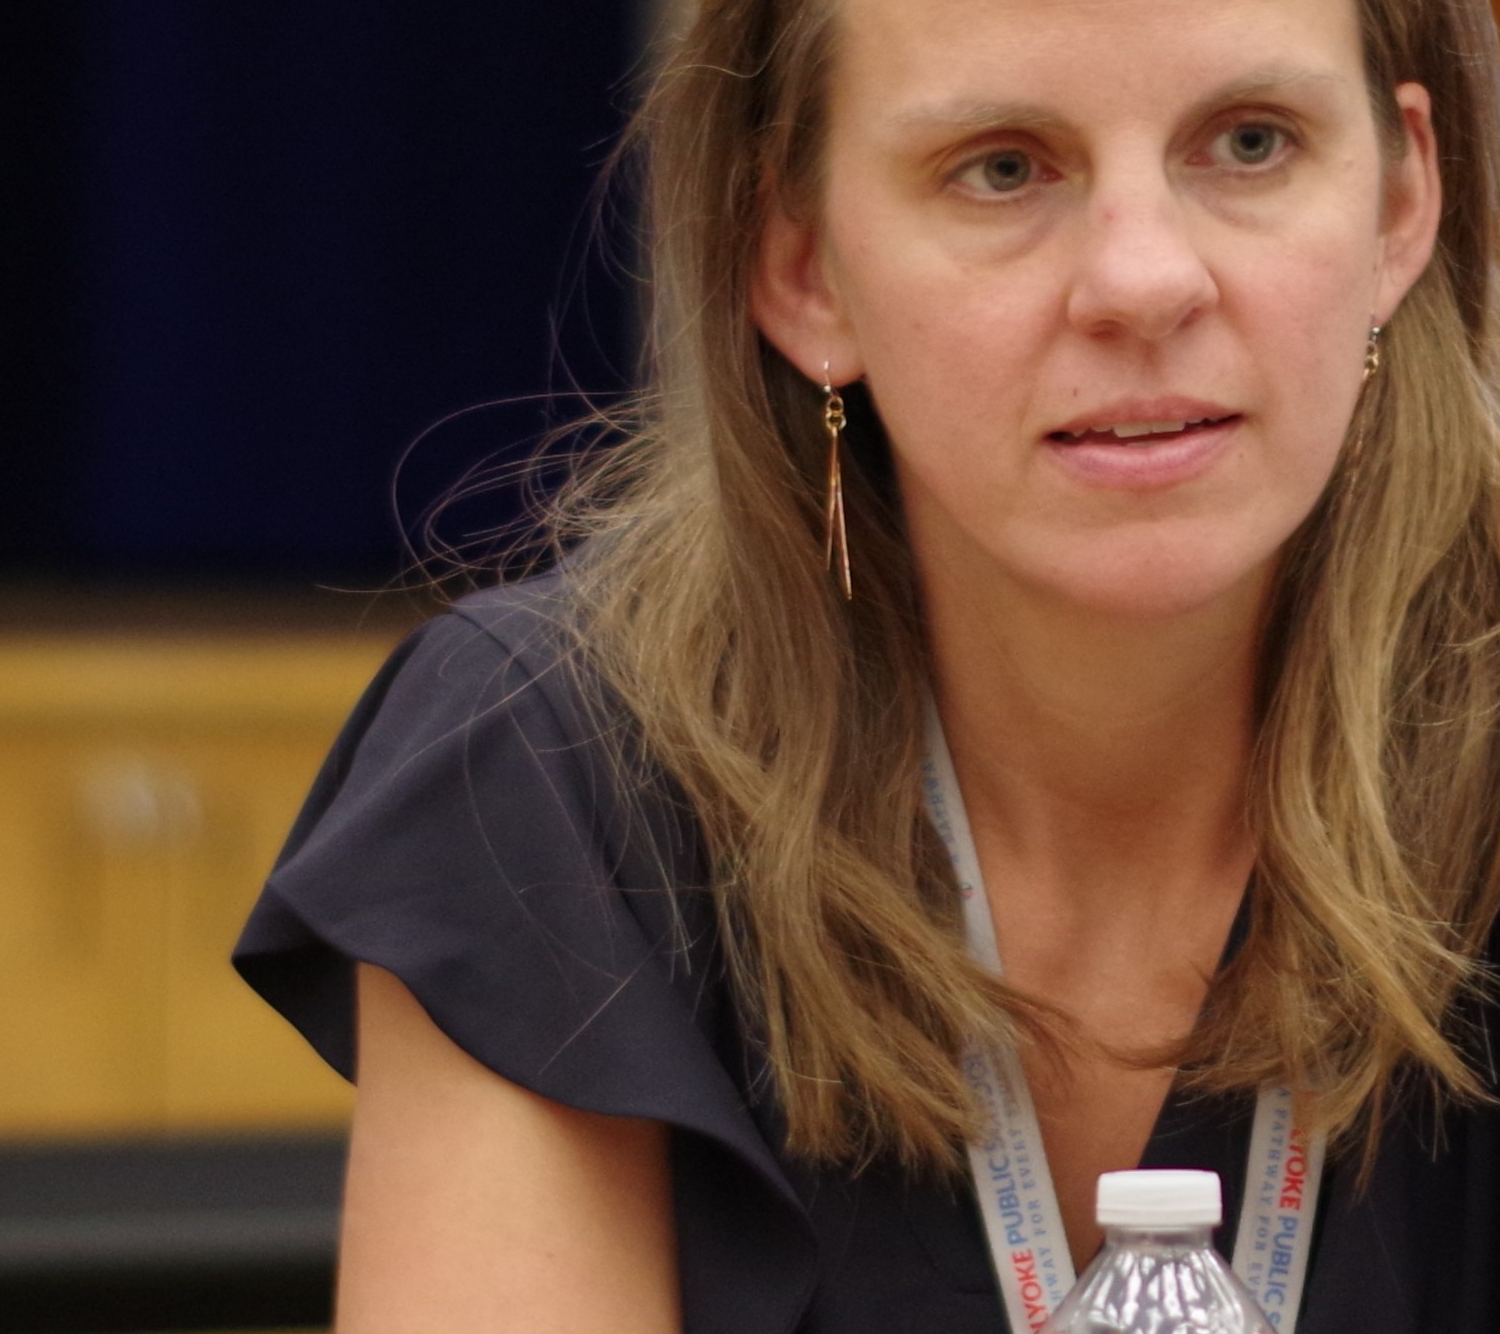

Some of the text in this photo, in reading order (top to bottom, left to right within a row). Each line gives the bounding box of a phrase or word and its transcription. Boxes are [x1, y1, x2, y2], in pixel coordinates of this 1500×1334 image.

[988, 1156, 1029, 1246] PUBLIC
[1259, 1108, 1289, 1207] PATHWAY
[1027, 1199, 1047, 1237] FOR
[1254, 1215, 1271, 1251] FOR
[1263, 1216, 1299, 1306] PUBLIC
